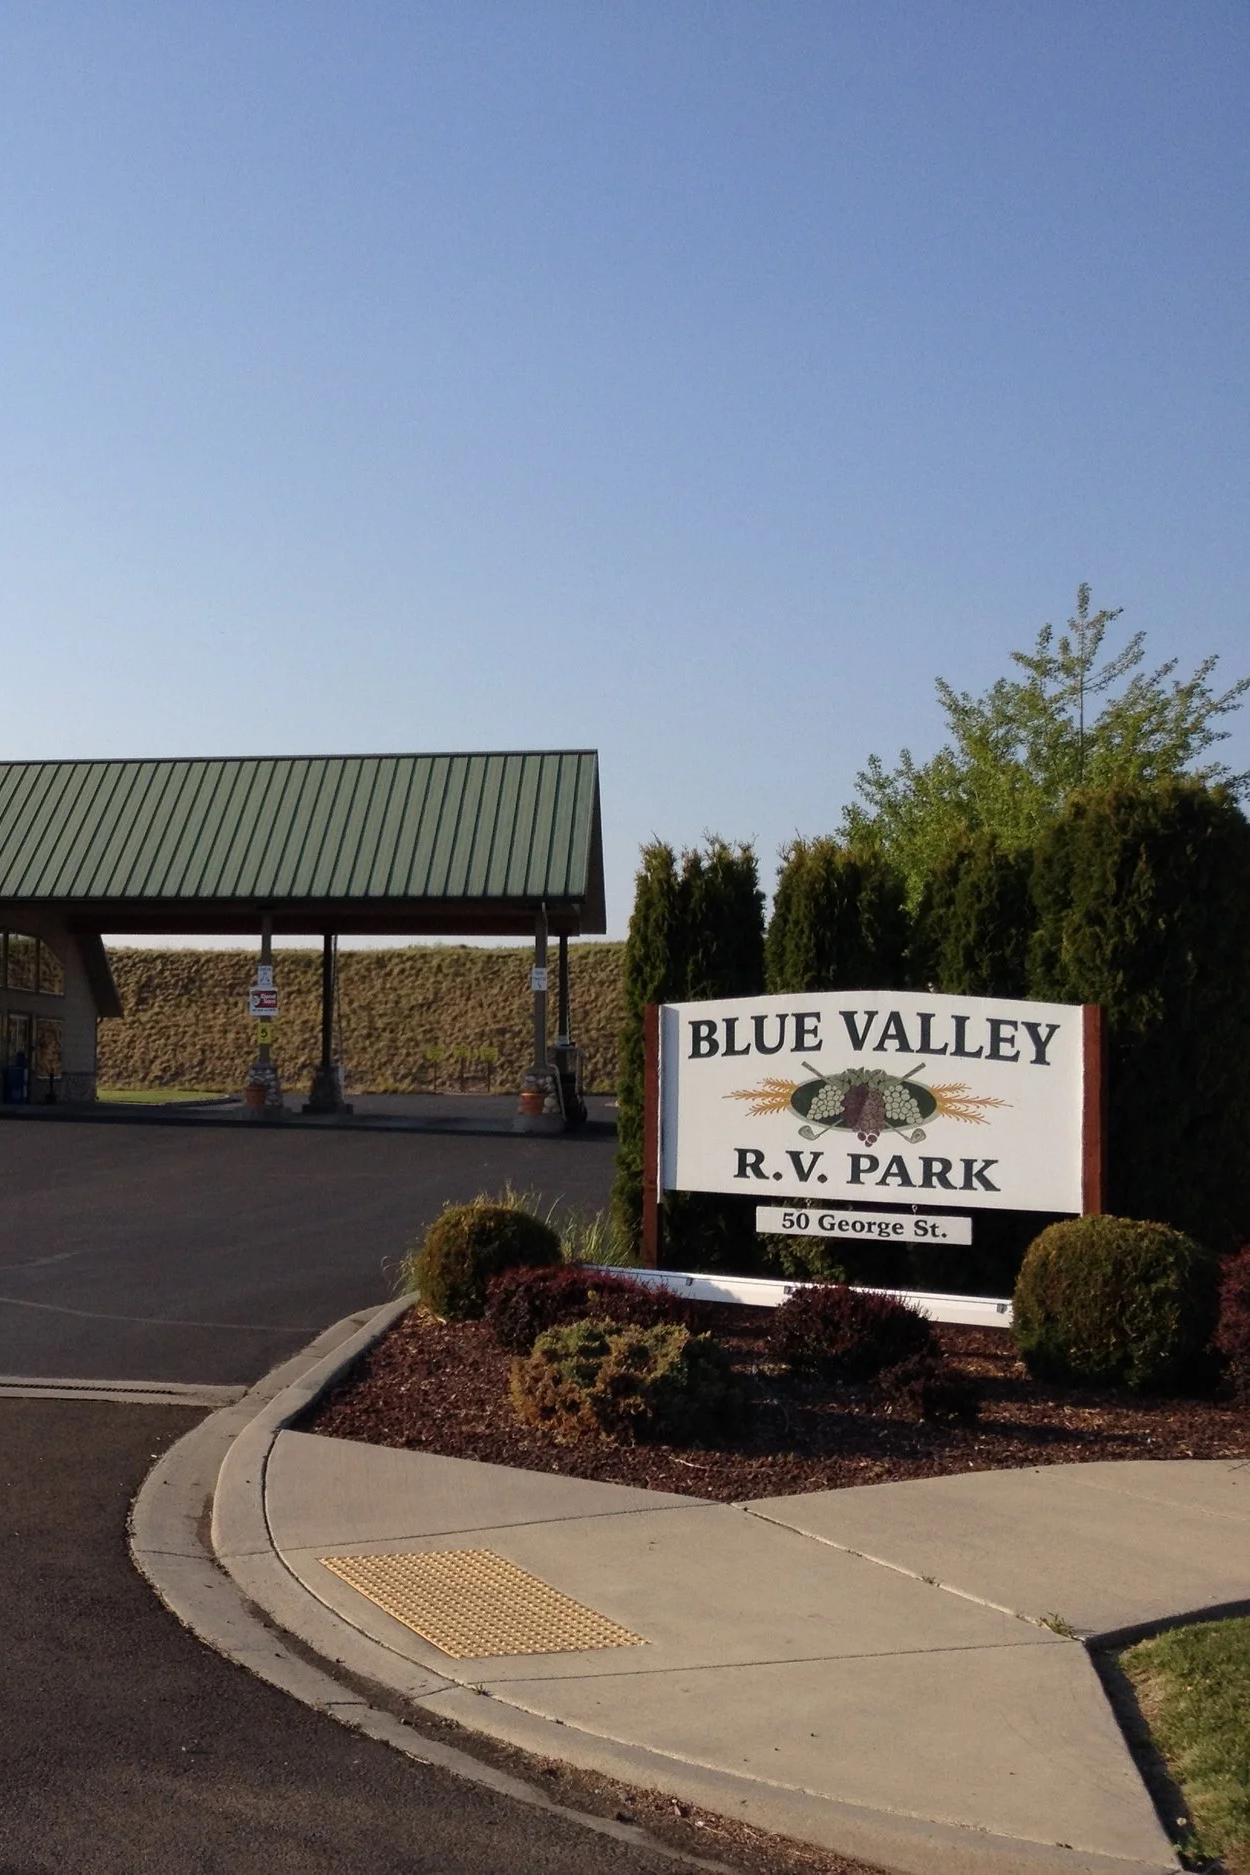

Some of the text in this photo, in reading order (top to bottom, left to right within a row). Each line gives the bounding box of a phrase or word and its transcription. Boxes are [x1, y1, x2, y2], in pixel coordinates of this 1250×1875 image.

[261, 1028, 268, 1038] 5
[688, 1010, 1060, 1065] BLUE VALLEY
[733, 1148, 1001, 1191] R.V. PARK
[781, 1212, 948, 1239] 50 George St.
